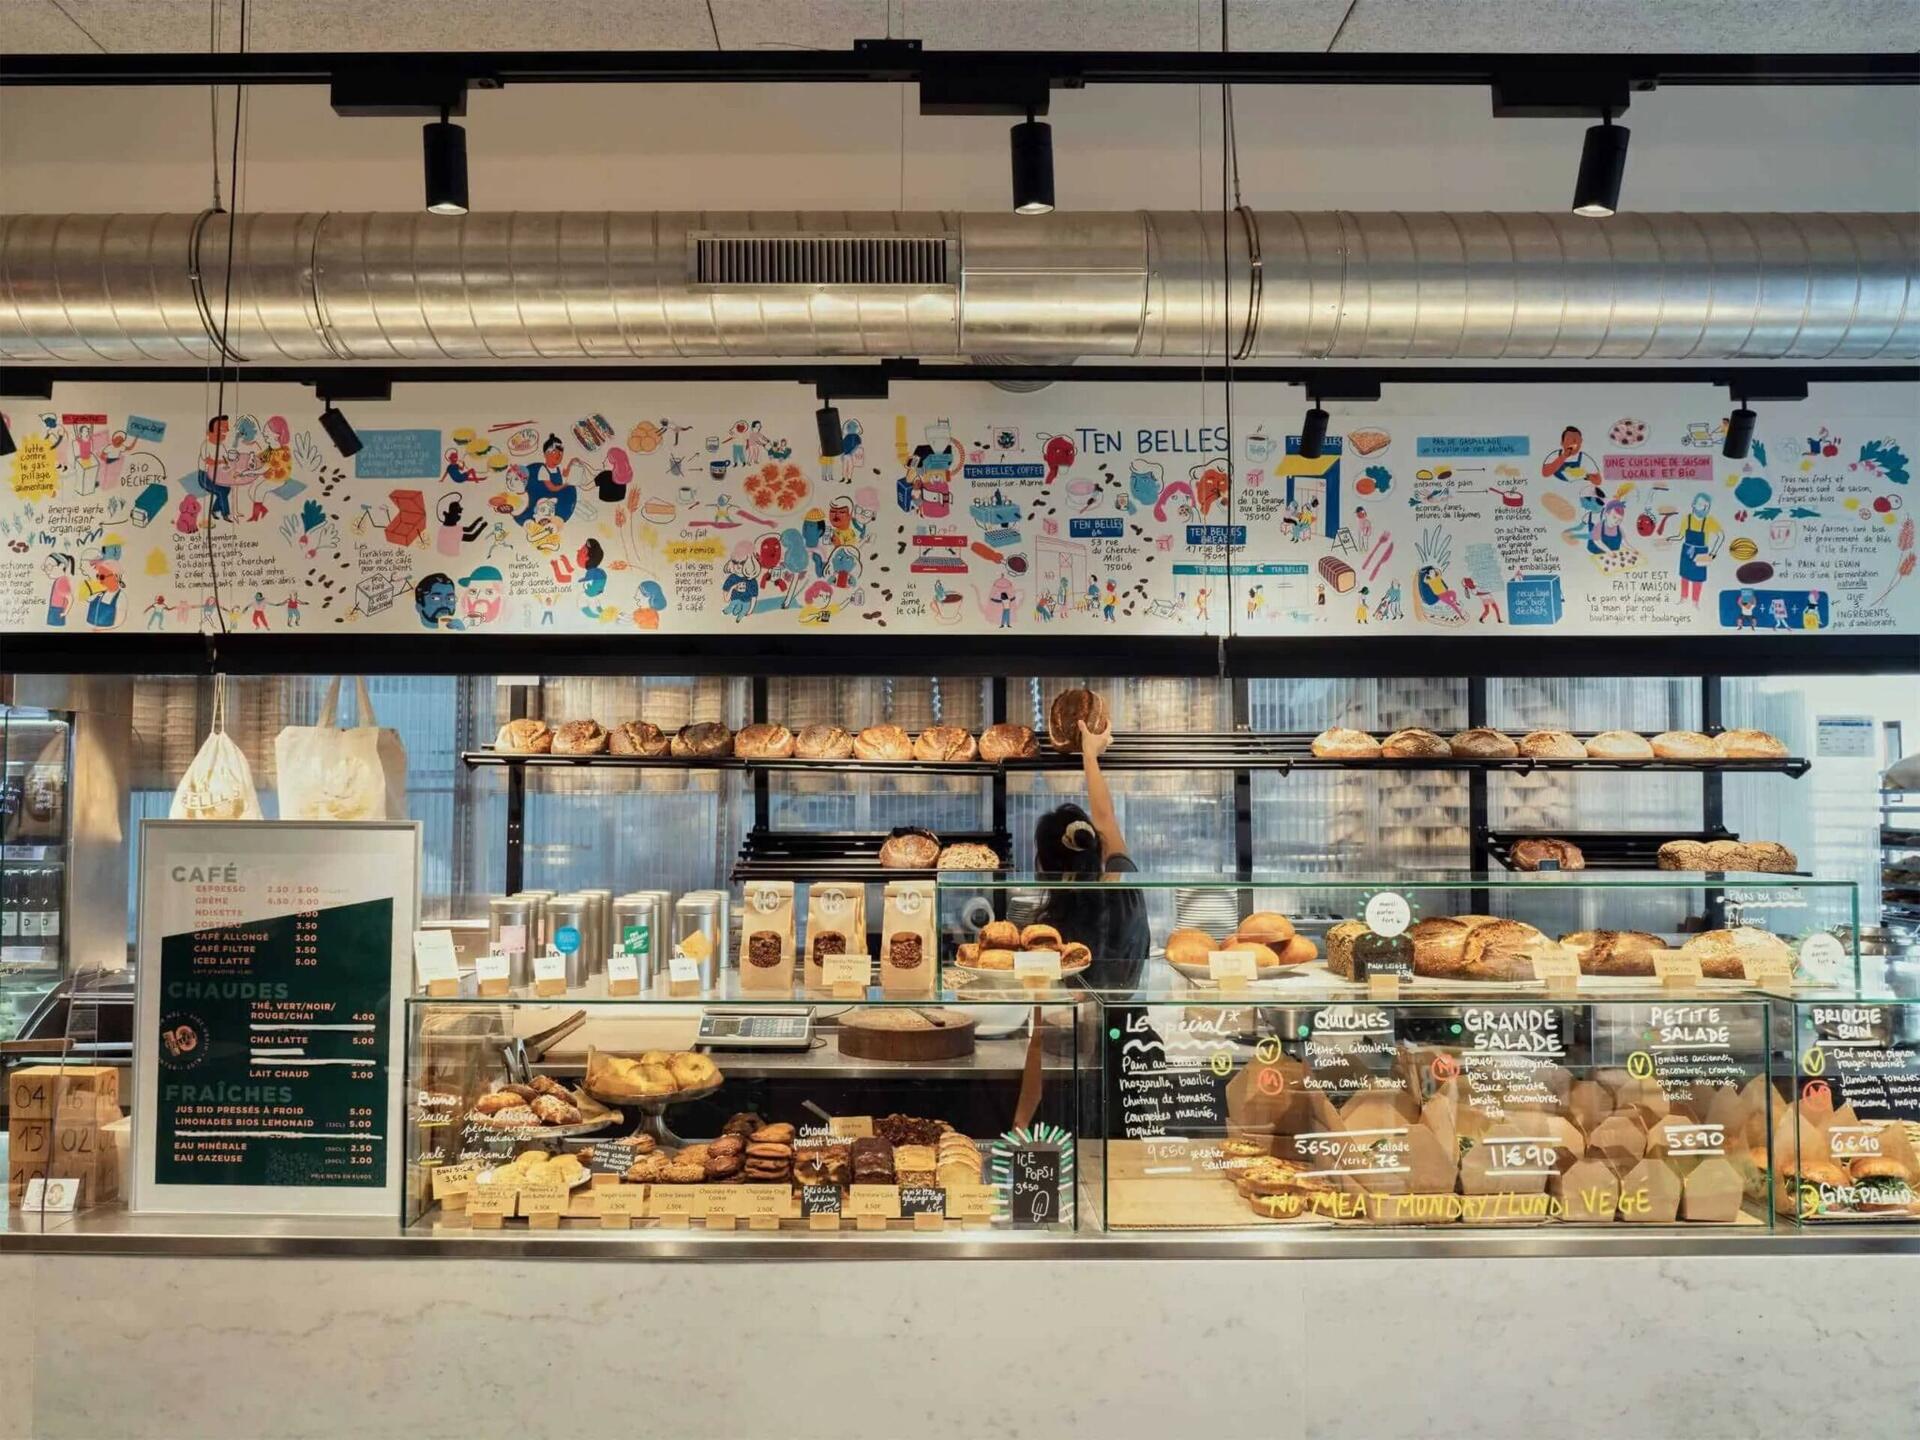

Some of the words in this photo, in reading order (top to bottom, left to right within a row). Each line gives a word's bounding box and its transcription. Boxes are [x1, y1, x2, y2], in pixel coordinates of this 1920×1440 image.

[1074, 428, 1122, 454] TEN
[1137, 426, 1230, 454] BELLES
[24, 445, 44, 454] lutte
[1605, 458, 1625, 468] UNE
[1628, 458, 1668, 468] CUISINE
[1668, 458, 1678, 467] DE
[964, 468, 984, 476] TEN
[985, 466, 1014, 476] BELLES
[1016, 466, 1044, 476] COFFEE
[1622, 470, 1656, 480] LOCALE
[1662, 468, 1674, 478] ET
[21, 472, 50, 484] pillage
[1262, 496, 1284, 507] Grange
[35, 514, 44, 524] et
[48, 514, 94, 526] fertilisant
[1072, 520, 1091, 530] TEN
[1094, 518, 1123, 529] BELLES
[680, 530, 692, 539] On
[694, 528, 707, 540] fait
[1189, 528, 1209, 537] TEN
[1212, 526, 1243, 536] BELLES
[1090, 538, 1102, 546] 53
[1852, 545, 1878, 554] France
[1104, 562, 1132, 571] 75006
[1624, 571, 1648, 580] TOUT
[1651, 570, 1668, 580] EST
[1612, 580, 1636, 591] FAIT
[1640, 581, 1676, 592] MAISON
[1600, 595, 1616, 604] pain
[906, 604, 926, 616] café
[172, 862, 238, 884] CAFÉ
[194, 932, 220, 942] CAFÉ
[222, 932, 269, 942] ALLONGÉ
[193, 944, 220, 954] CAFÉ
[222, 945, 256, 954] FILTRE
[193, 956, 216, 966] ICED
[220, 956, 250, 966] LATTE
[168, 982, 288, 1000] CHAUDES
[251, 1001, 274, 1012] THÉ,
[276, 1002, 336, 1012] VERT/NOIR/
[250, 1012, 314, 1021] ROUGE/CHAI
[352, 1012, 376, 1022] 4.00
[1314, 1010, 1390, 1030] QUICHES
[1464, 1008, 1558, 1032] GRANDE
[1812, 1008, 1882, 1025] BRIOCHE
[1660, 1026, 1730, 1042] SALADE
[1837, 1024, 1872, 1040] BUN
[250, 1036, 274, 1044] CHAI
[277, 1036, 309, 1044] LATTE
[352, 1036, 375, 1046] 5.00
[1474, 1032, 1562, 1052] SALADE
[1122, 1056, 1148, 1072] Pain
[1152, 1060, 1166, 1069] au
[1314, 1056, 1350, 1068] ricotta
[1650, 1052, 1689, 1066] Tomates
[1634, 1058, 1644, 1074] V
[249, 1070, 272, 1078] LAIT
[274, 1070, 310, 1078] CHAUD
[351, 1071, 374, 1079] 3.00
[1178, 1074, 1214, 1087] basilic,
[15, 1084, 46, 1110] 04
[166, 1081, 293, 1103] FRAÎCHES
[1162, 1093, 1174, 1104] de
[176, 1106, 194, 1114] JUS
[196, 1106, 214, 1114] BIO
[216, 1104, 260, 1114] PRESSÉS
[262, 1104, 270, 1114] À
[272, 1106, 304, 1115] FROID
[350, 1108, 372, 1116] 5.00
[176, 1118, 232, 1126] LIMONADES
[236, 1118, 259, 1126] BIOS
[262, 1118, 314, 1128] LEMONAID
[350, 1120, 372, 1128] 5.00
[18, 1126, 44, 1152] 13
[61, 1128, 92, 1152] 02
[174, 1142, 194, 1150] EAU
[197, 1140, 248, 1150] MINÉRALE
[794, 1138, 824, 1150] peanut
[1666, 1132, 1724, 1148] 5€90
[1831, 1132, 1879, 1152] 6€90
[174, 1154, 194, 1162] EAU
[197, 1154, 243, 1162] GAZEUSE
[1016, 1152, 1037, 1168] ICE
[1374, 1154, 1400, 1168] 7€
[1490, 1146, 1558, 1168] 11€90
[1025, 1166, 1054, 1182] POPS!
[802, 1186, 837, 1196] Brioche
[1311, 1192, 1390, 1216] MEAT
